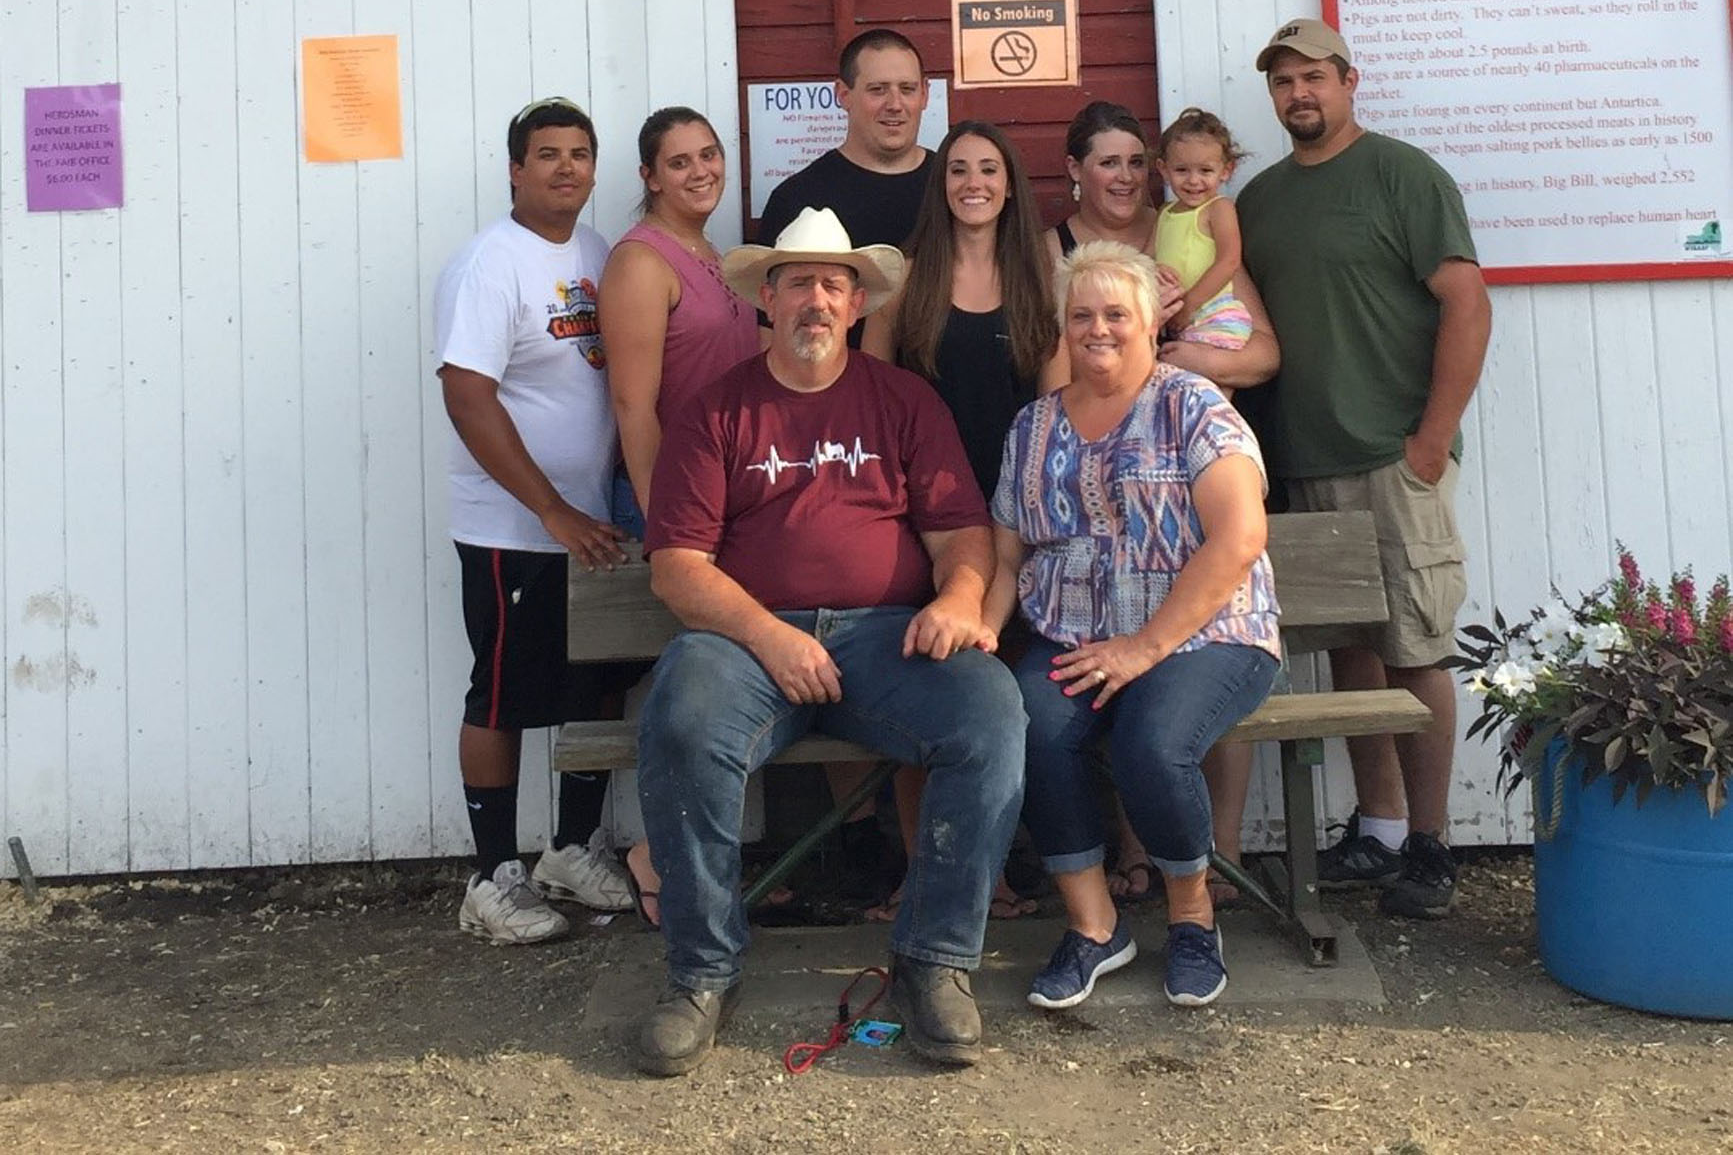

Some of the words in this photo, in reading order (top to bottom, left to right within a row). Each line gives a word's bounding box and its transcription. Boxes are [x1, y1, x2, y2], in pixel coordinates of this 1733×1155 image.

[971, 6, 991, 21] No
[994, 5, 1054, 22] Smoking
[1352, 12, 1380, 28] Pigs
[1383, 12, 1402, 24] are
[1407, 11, 1426, 22] not
[1473, 6, 1503, 21] They
[1589, 4, 1602, 14] so
[1606, 1, 1632, 16] they
[1637, 0, 1658, 13] roll
[1663, 0, 1675, 11] in
[1277, 25, 1301, 41] CAT
[1353, 32, 1381, 45] mud
[1385, 31, 1398, 43] to
[1402, 29, 1432, 44] keep
[1354, 50, 1381, 65] Pigs
[1385, 47, 1424, 64] weigh
[1429, 46, 1464, 60] about
[1468, 45, 1487, 57] 2.5
[1492, 43, 1538, 59] pounds
[1542, 42, 1554, 54] at
[1558, 40, 1591, 53] birth.
[1393, 69, 1412, 80] are
[1416, 70, 1423, 79] a
[1427, 67, 1469, 79] source
[1473, 63, 1488, 76] of
[1491, 62, 1530, 77] nearly
[1534, 60, 1550, 73] 40
[1554, 56, 1658, 75] pharmaceuticals
[1661, 58, 1677, 69] on
[1681, 55, 1700, 68] the
[764, 87, 801, 111] FOR
[1357, 107, 1385, 122] Pigs
[1389, 107, 1409, 119] are
[1454, 104, 1470, 115] on
[1474, 101, 1510, 117] every
[1513, 98, 1573, 113] continent
[1577, 96, 1597, 110] but
[1404, 125, 1416, 137] in
[1419, 125, 1443, 136] one
[1447, 121, 1460, 135] of
[1464, 120, 1485, 134] the
[1488, 119, 1526, 133] oldest
[1530, 116, 1593, 133] processed
[1597, 116, 1635, 128] meats
[1639, 115, 1651, 127] in
[1654, 112, 1698, 128] history
[1443, 140, 1483, 157] began
[1486, 138, 1526, 154] salting
[1533, 136, 1562, 153] pork
[1566, 134, 1608, 149] bellies
[1612, 135, 1625, 146] as
[1629, 133, 1660, 149] early
[1664, 134, 1678, 145] as
[1683, 131, 1713, 144] 1500
[1475, 178, 1488, 190] in
[1543, 174, 1567, 190] Big
[1602, 171, 1656, 188] weighed
[1470, 216, 1501, 229] have
[1504, 214, 1535, 228] been
[1538, 212, 1568, 227] used
[1571, 213, 1585, 225] to
[1588, 210, 1634, 227] replace
[1638, 209, 1683, 223] human
[1685, 207, 1718, 220] heart
